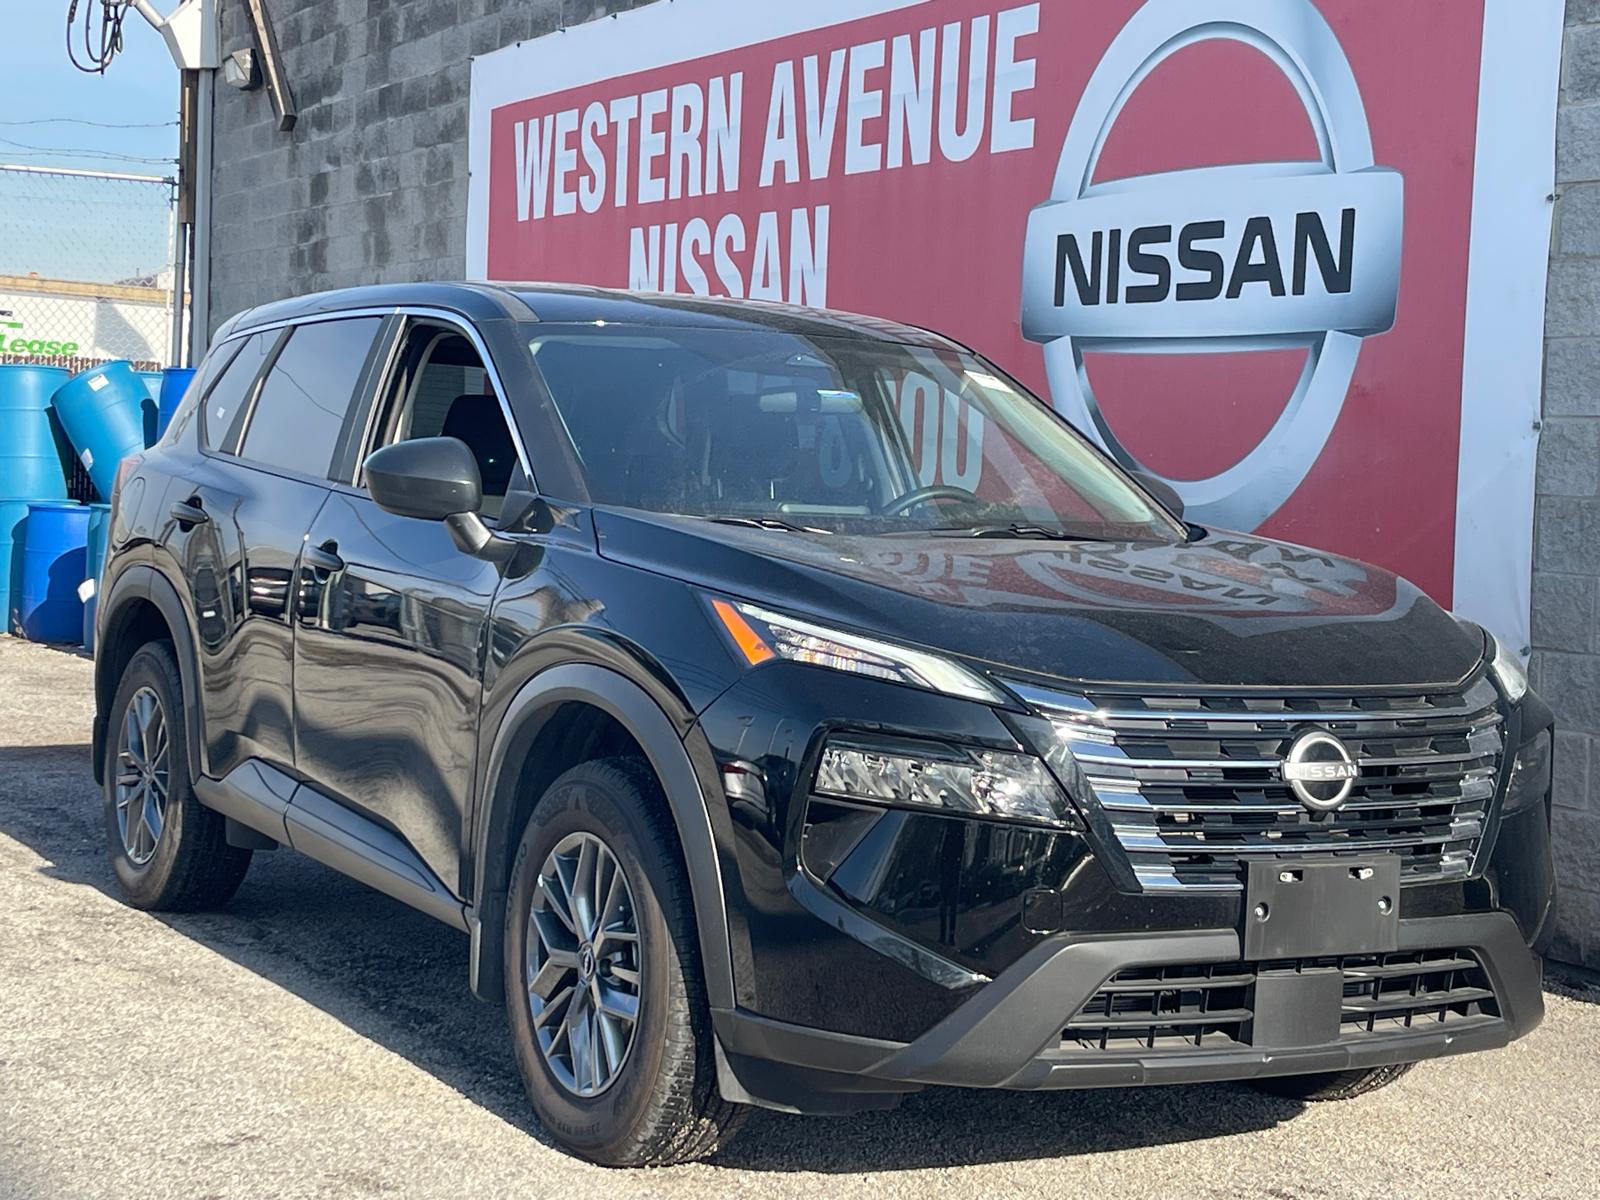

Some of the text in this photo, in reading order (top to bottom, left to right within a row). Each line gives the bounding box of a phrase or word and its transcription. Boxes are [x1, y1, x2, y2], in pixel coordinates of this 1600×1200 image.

[514, 2, 1040, 221] WESTERN AVENUE
[628, 204, 831, 309] NISSAN
[1053, 208, 1356, 307] NISSAN
[1289, 764, 1358, 778] NISSAN
